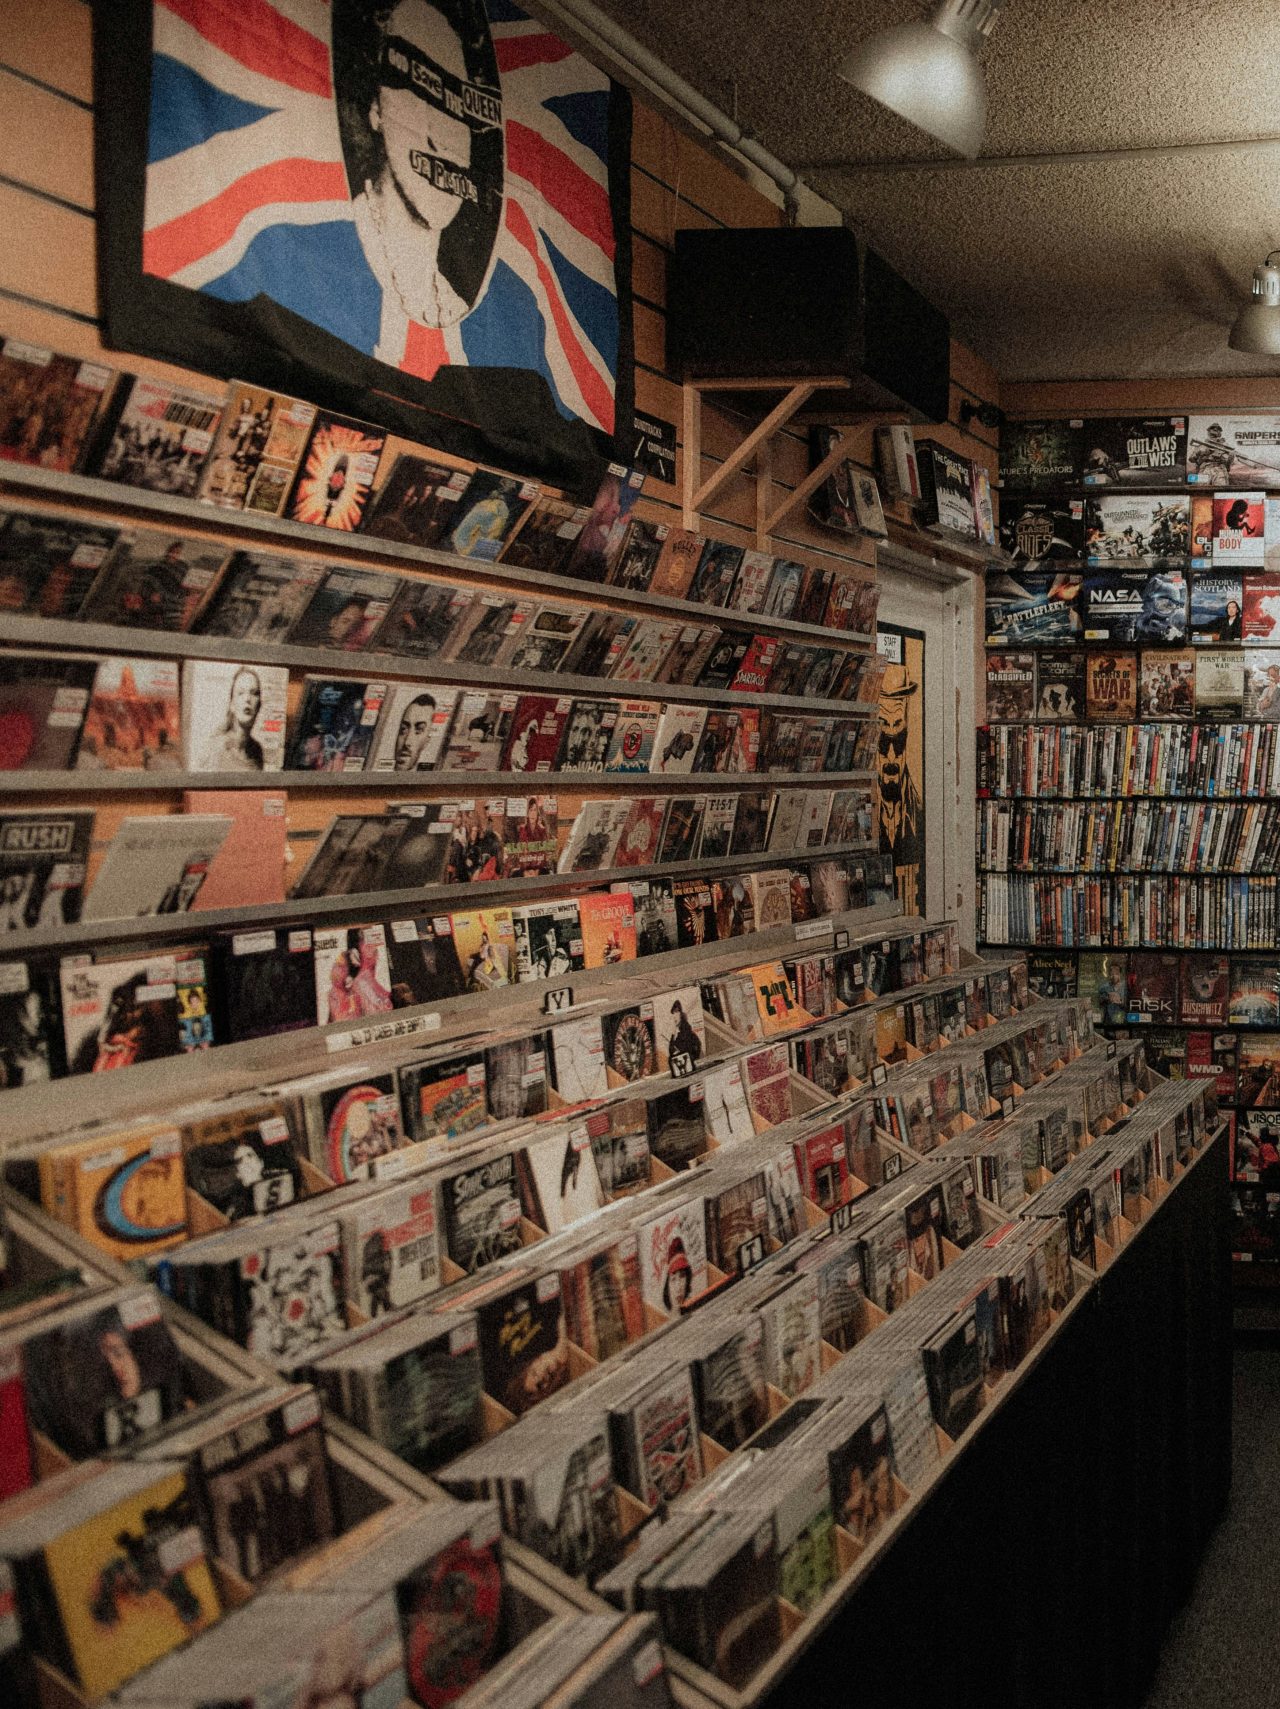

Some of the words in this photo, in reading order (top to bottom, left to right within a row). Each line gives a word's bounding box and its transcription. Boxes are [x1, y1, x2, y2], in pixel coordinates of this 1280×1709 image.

[462, 87, 501, 126] QUEEN
[1126, 436, 1177, 454] OUTLAWS
[1149, 451, 1176, 467] WEST
[999, 467, 1027, 476] ATURE'S
[1029, 466, 1073, 475] PREDATORS
[1219, 539, 1242, 549] BODY
[1194, 585, 1241, 593] SCOTLAND
[1090, 590, 1142, 602] NASA
[884, 637, 896, 646] STAFF
[1222, 655, 1245, 663] WORLD
[988, 672, 1033, 681] CLASSIFIED
[1093, 679, 1131, 699] WAR
[6, 826, 69, 849] RUSH
[529, 906, 545, 917] TONY
[558, 903, 577, 913] WHITE
[602, 905, 631, 919] GROOVE
[1129, 1000, 1173, 1012] RISK
[1189, 1064, 1224, 1074] WMD
